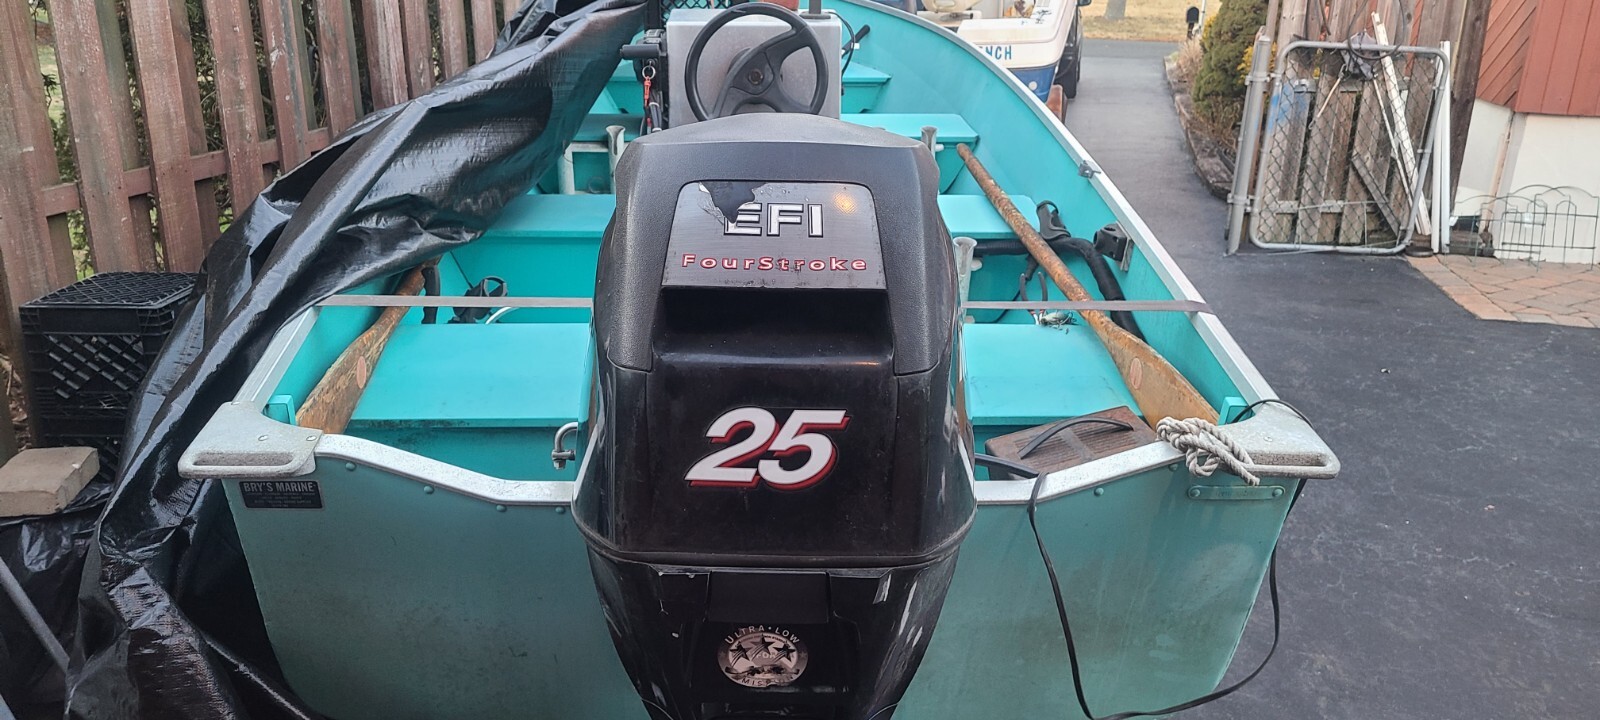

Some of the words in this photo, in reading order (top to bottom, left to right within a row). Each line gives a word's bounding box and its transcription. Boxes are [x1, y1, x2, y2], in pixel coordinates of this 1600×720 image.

[979, 45, 1012, 60] NCH
[723, 202, 824, 238] EFI
[681, 253, 867, 271] FourStroke
[684, 405, 850, 490] 25
[243, 482, 273, 492] BRY'S
[275, 482, 315, 492] MARINE
[724, 625, 765, 644] ULTRA
[775, 626, 800, 644] LOW
